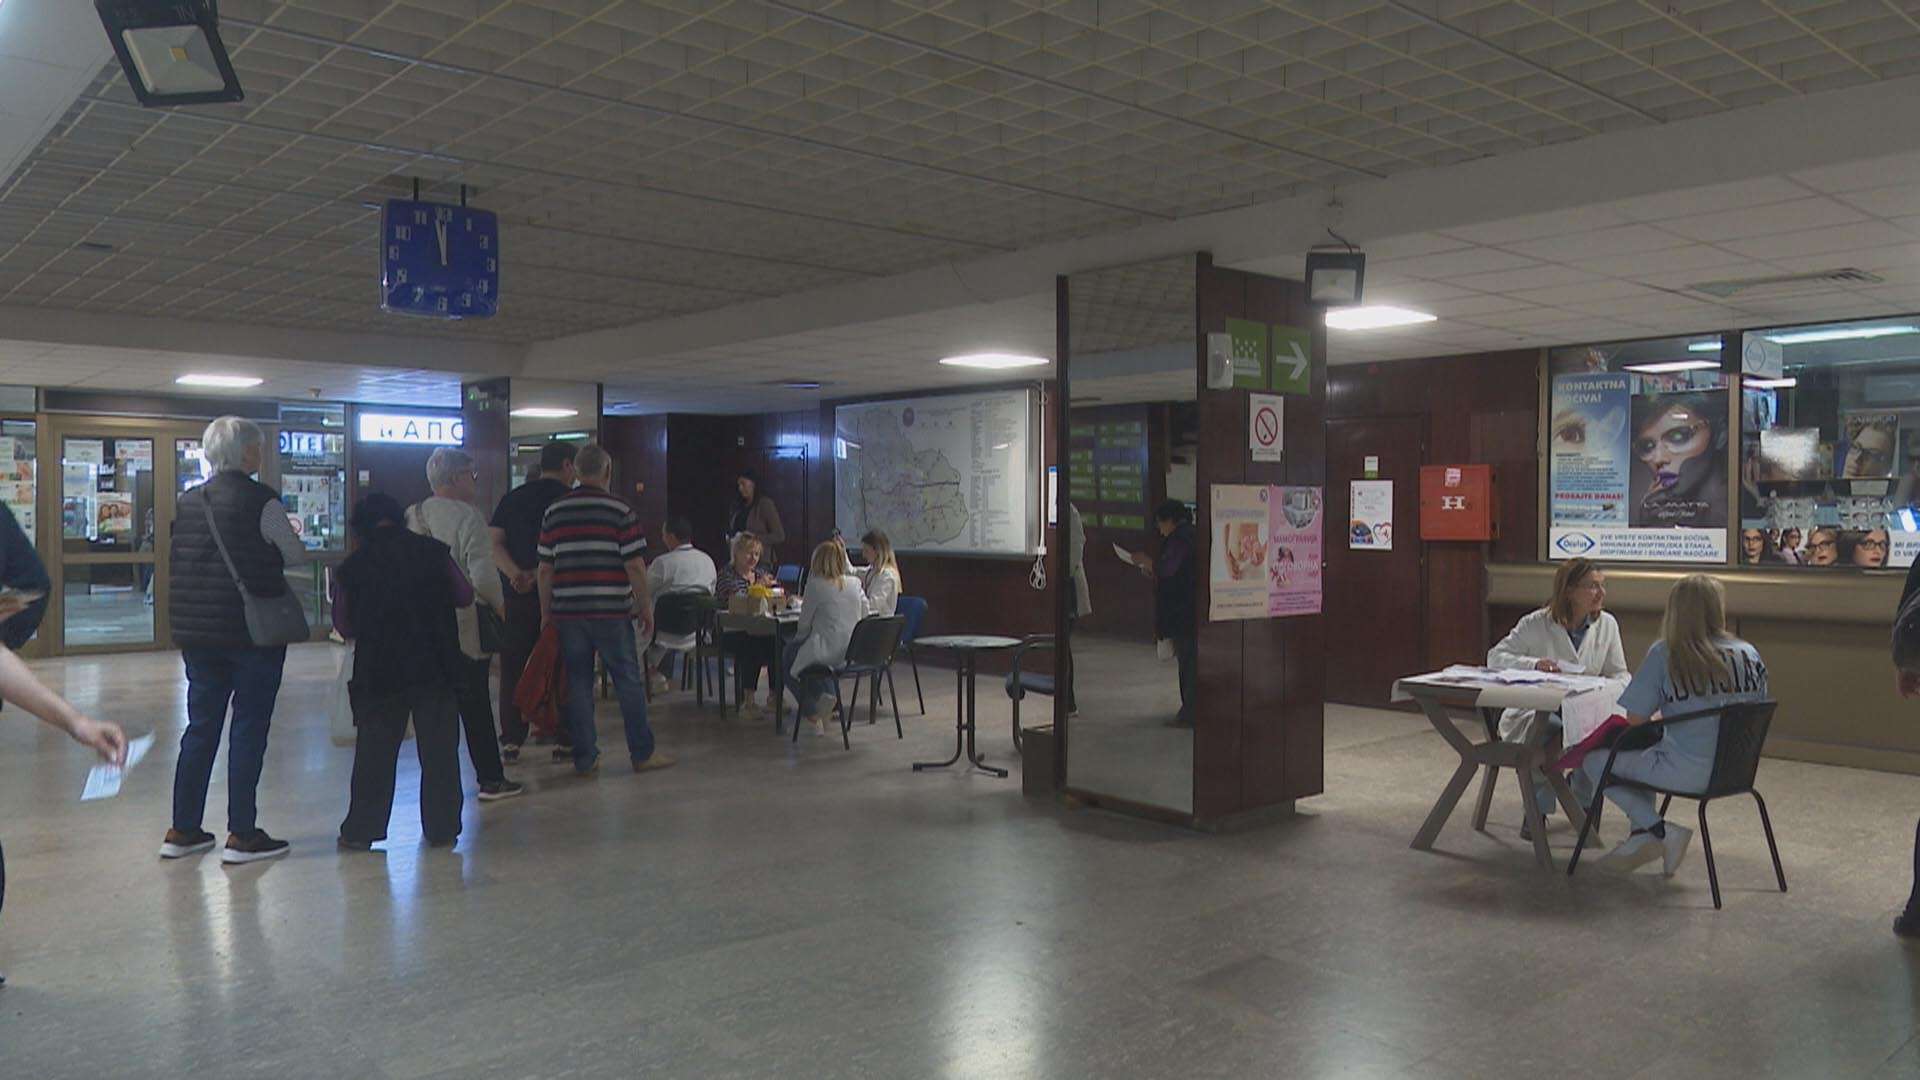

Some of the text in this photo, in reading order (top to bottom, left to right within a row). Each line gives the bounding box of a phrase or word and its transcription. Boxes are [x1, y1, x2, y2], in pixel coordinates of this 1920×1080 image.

[415, 210, 427, 224] 11
[414, 287, 424, 302] 7
[1441, 495, 1466, 510] H
